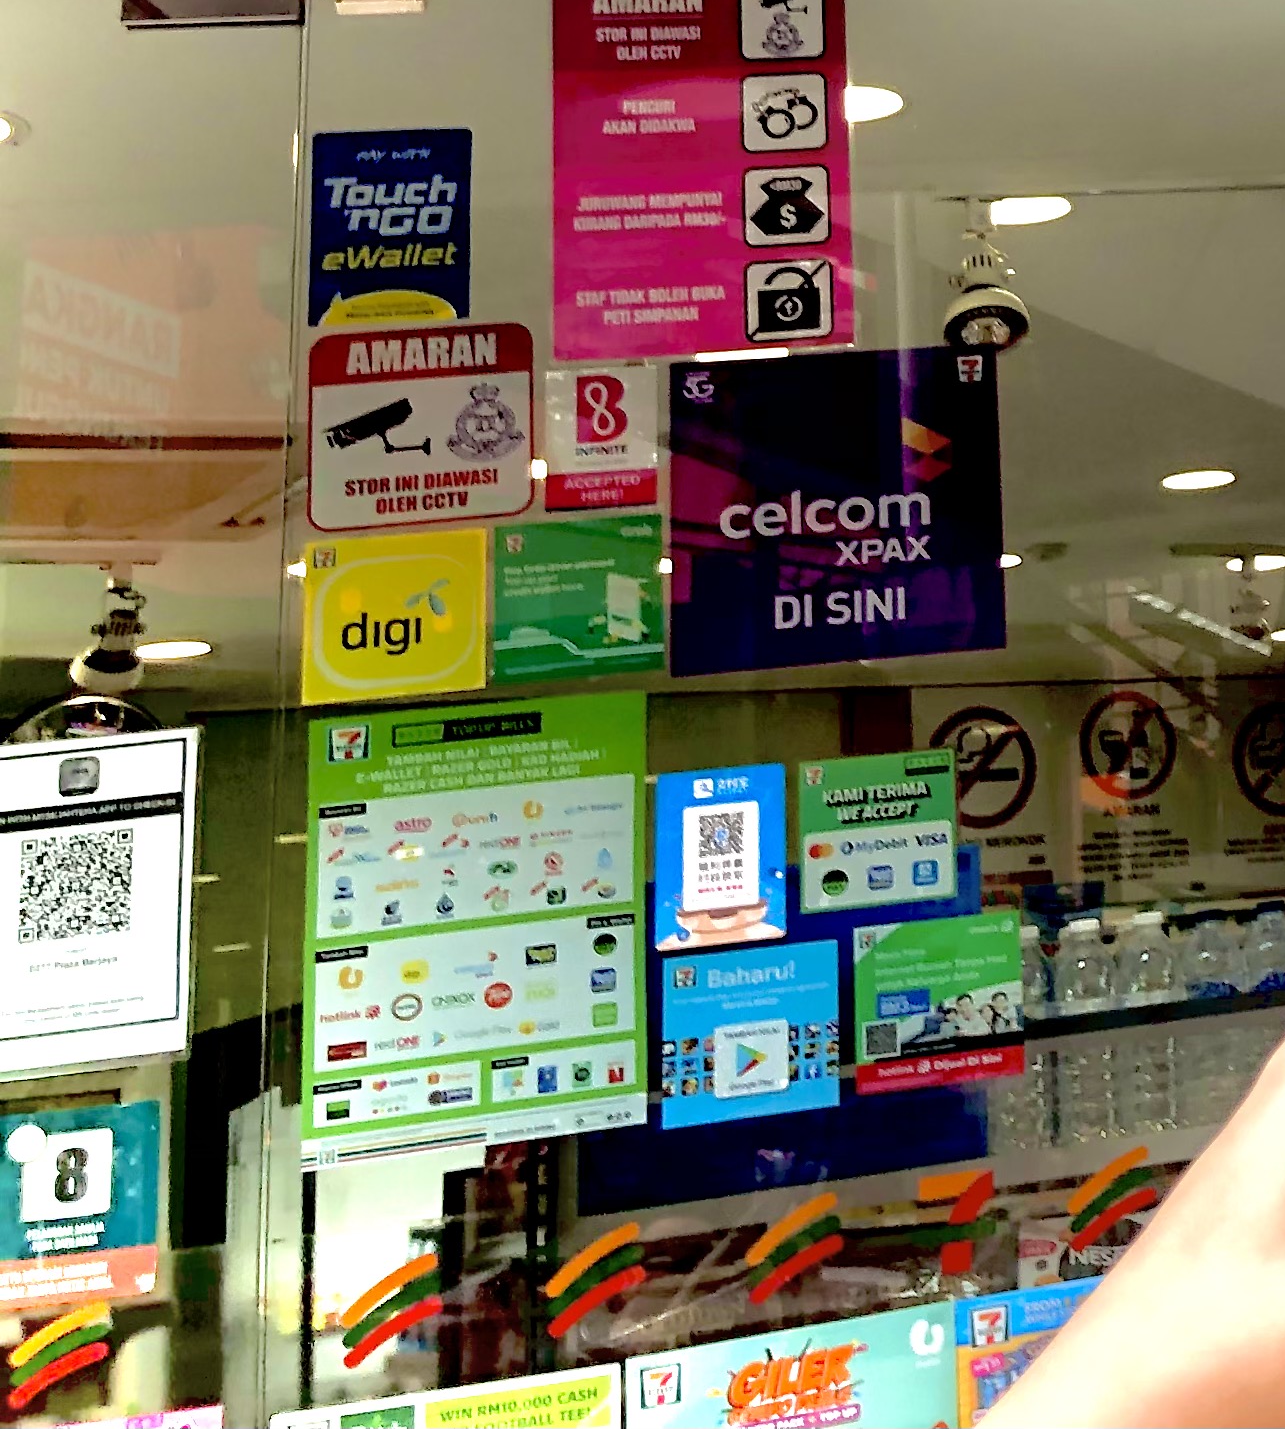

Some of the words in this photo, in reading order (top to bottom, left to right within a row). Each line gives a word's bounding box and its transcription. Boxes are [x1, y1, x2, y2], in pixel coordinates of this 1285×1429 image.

[595, 26, 628, 43] STOR
[630, 26, 648, 42] INI
[650, 25, 701, 42] DIAWASI
[616, 45, 648, 61] OLEH
[650, 45, 681, 60] CCTV
[323, 173, 458, 209] Touch
[321, 241, 459, 271] eWallet
[346, 333, 498, 376] AMARAN
[345, 478, 388, 497] STOR
[395, 474, 419, 493] INI
[428, 468, 498, 490] DIAWASI
[564, 474, 641, 490] ACCEPTED
[376, 496, 418, 515] OLEH
[422, 491, 469, 512] CCTV
[719, 489, 932, 540] celcom
[835, 534, 932, 567] XPAX
[774, 593, 813, 630] DI
[826, 586, 906, 626] SINI
[341, 611, 422, 656] digi
[822, 786, 864, 805] KAMI
[867, 780, 929, 800] TERIMA
[836, 806, 862, 822] WE
[862, 801, 917, 820] ACCEPT
[707, 959, 796, 989] Baharu!
[54, 1147, 89, 1203] 8
[728, 1344, 854, 1409] GILER
[440, 1408, 473, 1423] WIN
[557, 1387, 598, 1406] CASH
